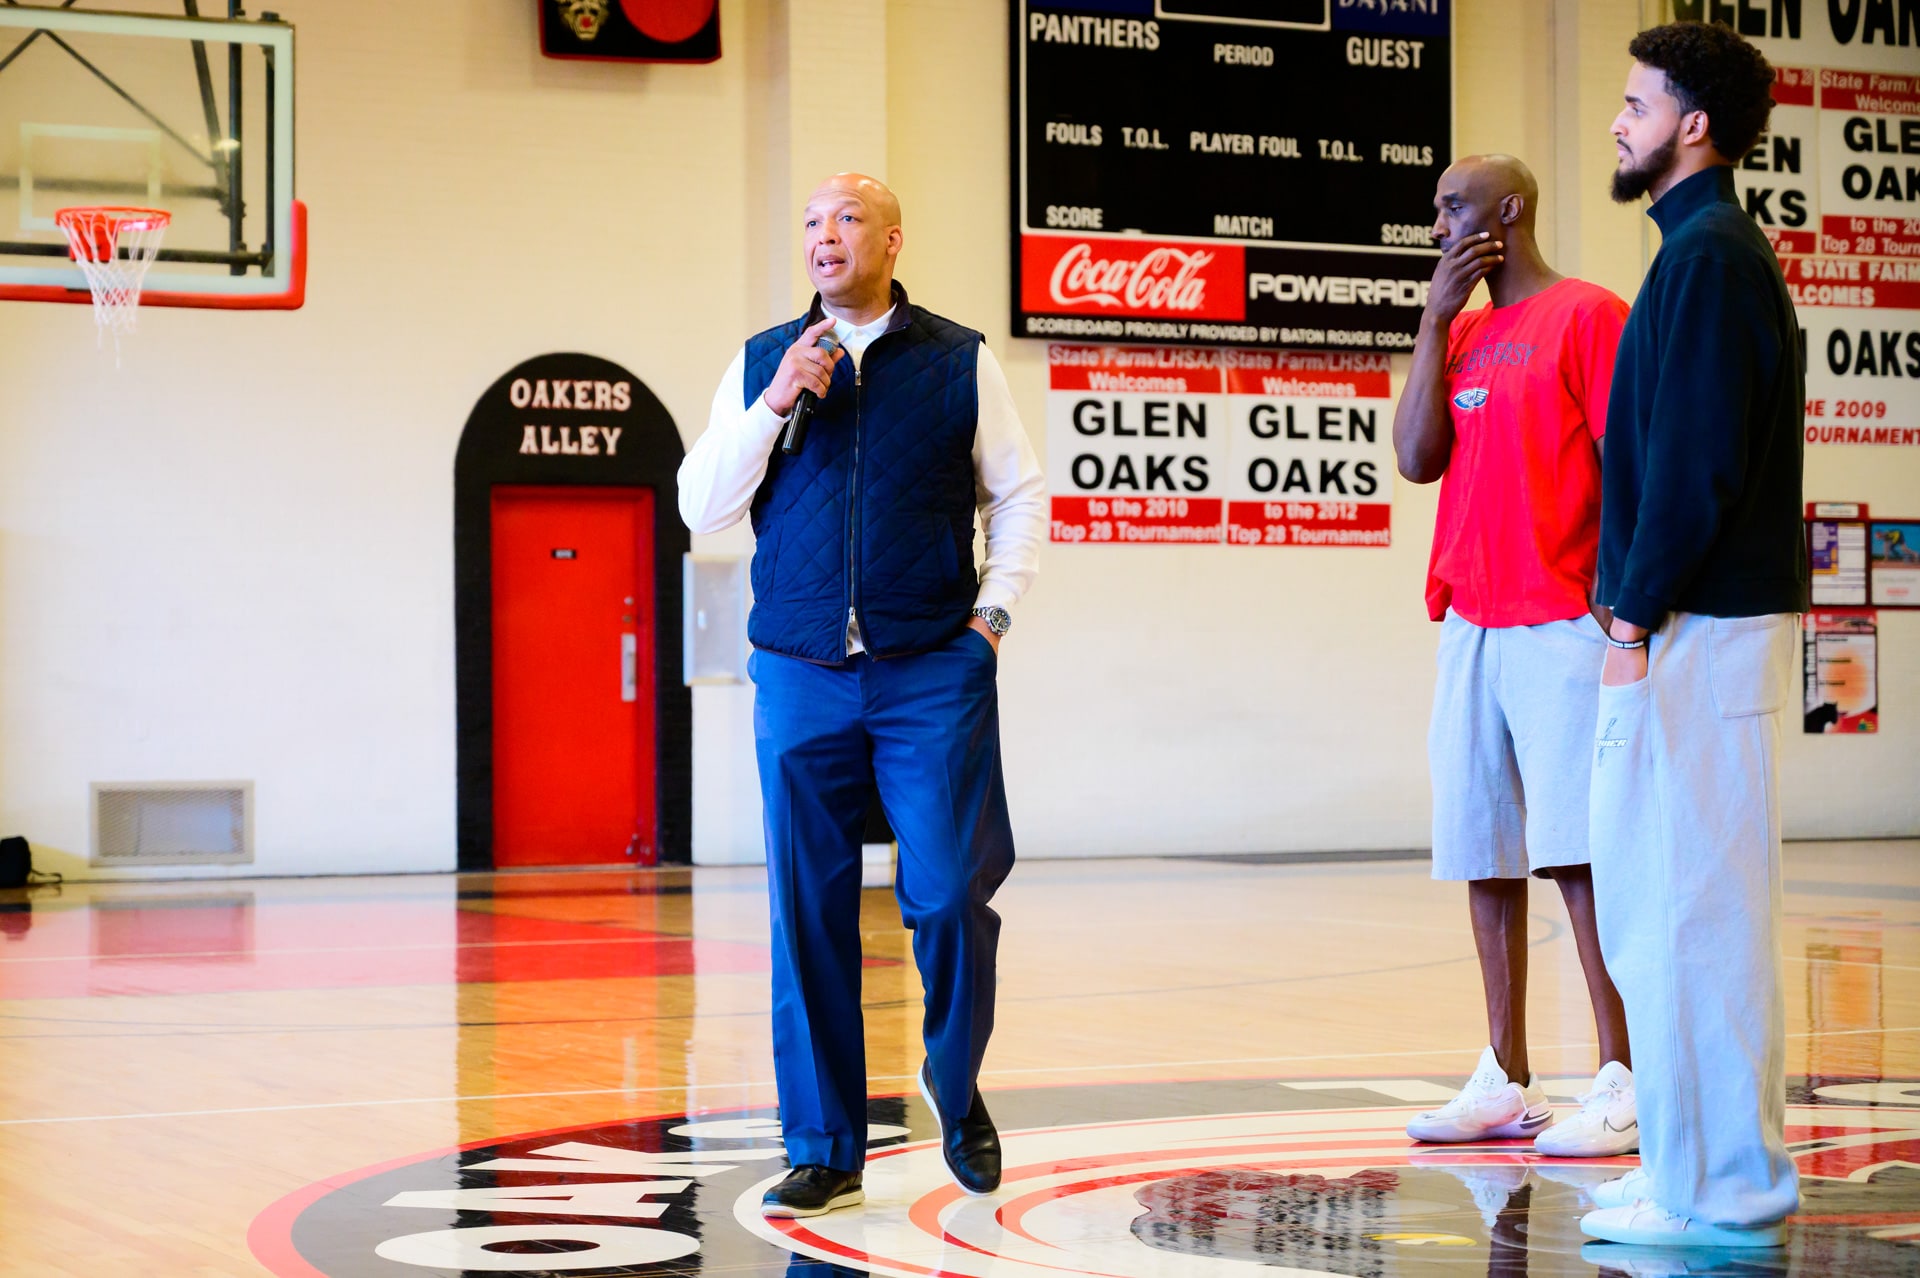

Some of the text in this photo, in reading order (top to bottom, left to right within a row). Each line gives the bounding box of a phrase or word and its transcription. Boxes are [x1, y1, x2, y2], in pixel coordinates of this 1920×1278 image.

[1030, 12, 1161, 51] PANTHERS
[1213, 42, 1274, 67] PERIOD
[1346, 36, 1425, 69] GUEST
[1821, 71, 1863, 89] State
[1046, 122, 1103, 146] FOULS
[1121, 127, 1169, 150] T.O.L.
[1190, 131, 1302, 158] PLAYER FOUL
[1318, 139, 1363, 162] T.O.L.
[1380, 143, 1433, 166] FOULS
[1741, 136, 1801, 174] EN
[1046, 205, 1103, 229] SCORE
[1746, 187, 1807, 227] KS
[1214, 214, 1274, 238] MATCH
[1381, 223, 1434, 246] SCORE
[1849, 216, 1868, 233] to
[1872, 217, 1898, 236] the
[1822, 233, 1850, 255] Top
[1855, 235, 1876, 254] 28
[1049, 243, 1215, 311] Coca-Cola
[1800, 258, 1861, 281] STATE
[1026, 317, 1124, 337] SCOREBOARD
[1125, 323, 1189, 340] PROUDLY
[1190, 324, 1259, 342] PROVIDED
[1260, 327, 1280, 343] BY
[1280, 328, 1326, 344] BATON
[1326, 329, 1374, 346] ROUGE
[1049, 346, 1101, 367] State
[1225, 350, 1273, 371] State
[1828, 328, 1920, 378] OAKS
[1087, 371, 1188, 393] Welcomes
[1261, 376, 1357, 398] Welcomes
[510, 378, 632, 411] OAKERS
[1072, 399, 1207, 438] GLEN
[1834, 400, 1886, 418] 2009
[1248, 404, 1377, 443] GLEN
[518, 425, 623, 456] ALLEY
[1803, 426, 1920, 446] OURNAMENT
[1071, 453, 1210, 492] OAKS
[1247, 457, 1378, 496] OAKS
[1088, 498, 1189, 519] to the 2010
[1264, 502, 1358, 520] to the 2012
[1051, 521, 1223, 543] Top 28 Tournament
[1229, 524, 1390, 546] Top 28 Tournament
